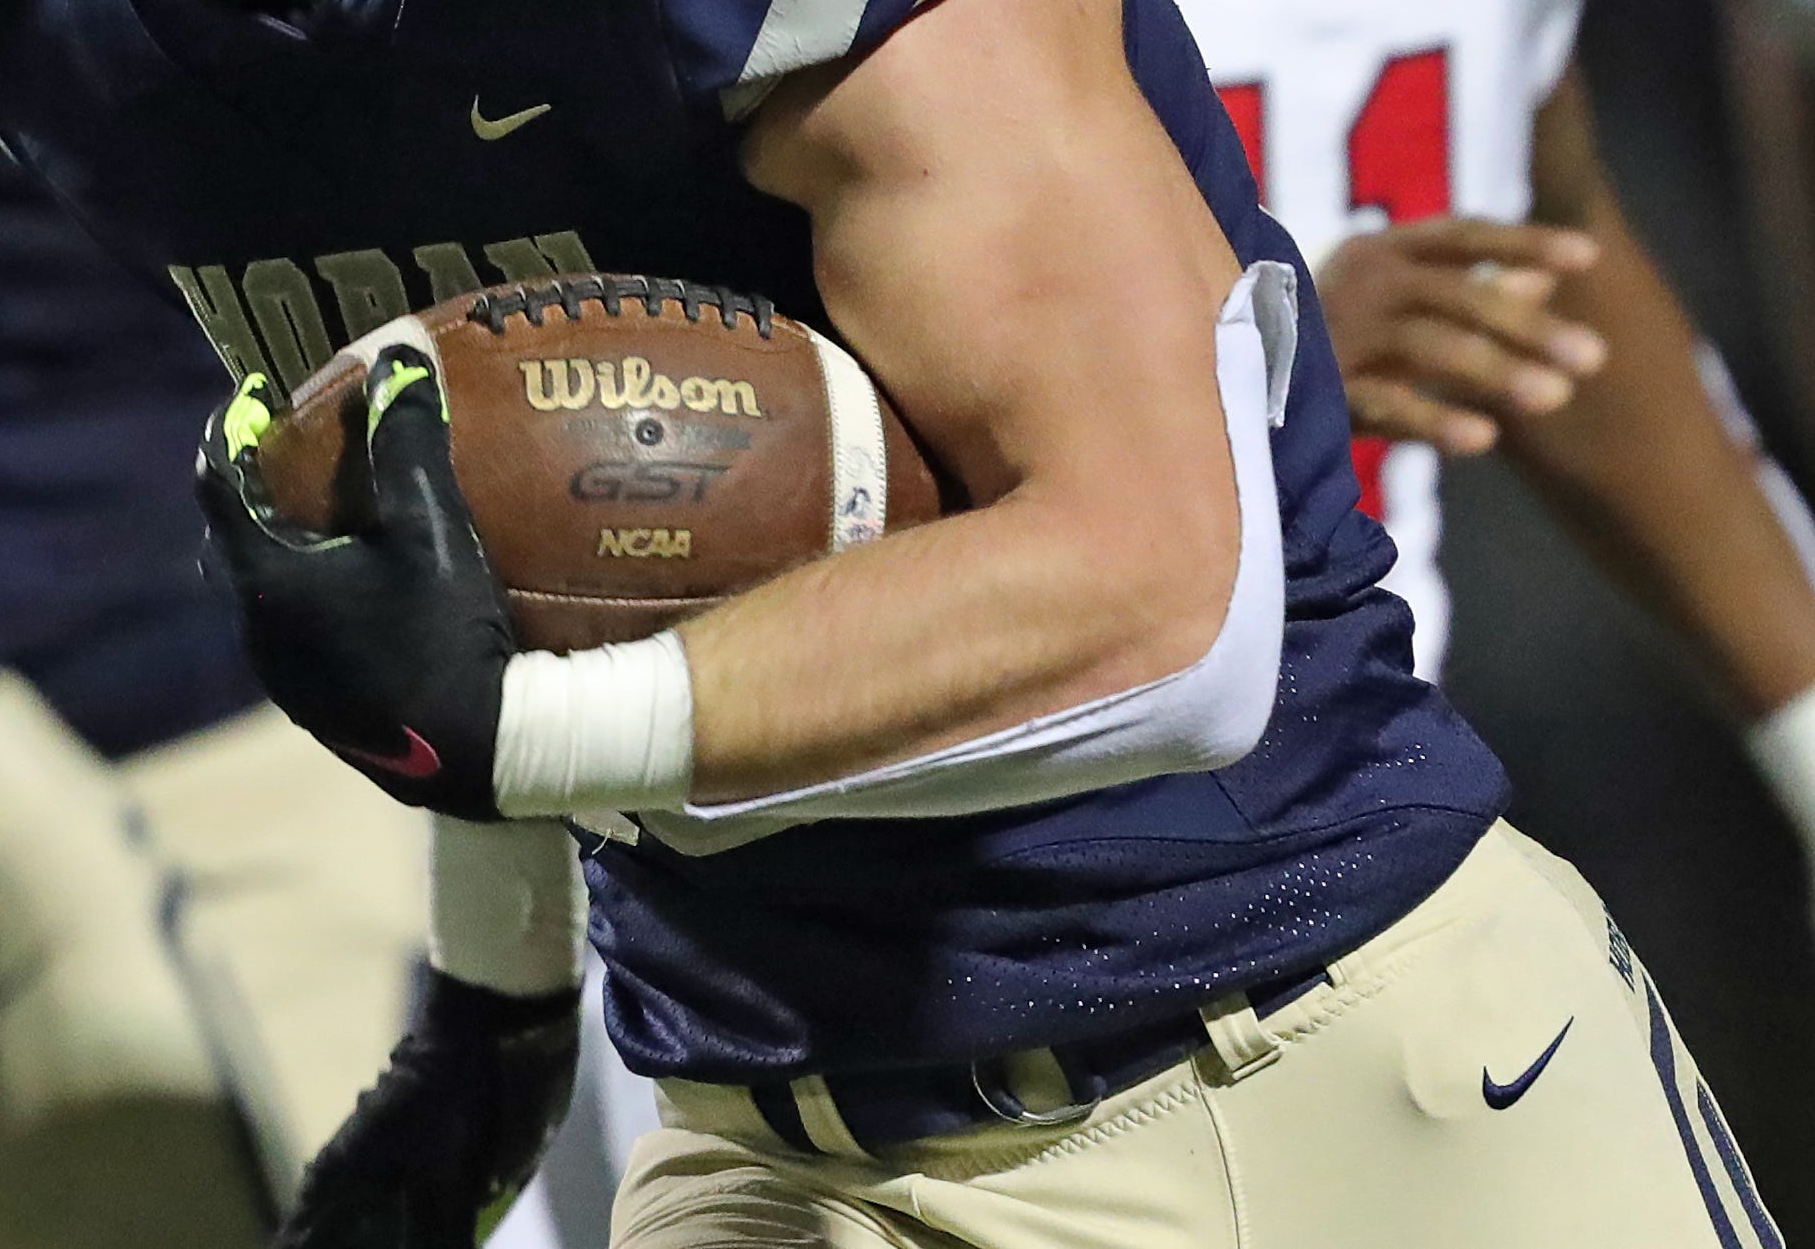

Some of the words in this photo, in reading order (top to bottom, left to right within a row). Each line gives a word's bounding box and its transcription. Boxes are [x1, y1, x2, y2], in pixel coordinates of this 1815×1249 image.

[518, 355, 764, 419] Wilson
[569, 457, 733, 506] GST
[595, 527, 694, 559] NCAA
